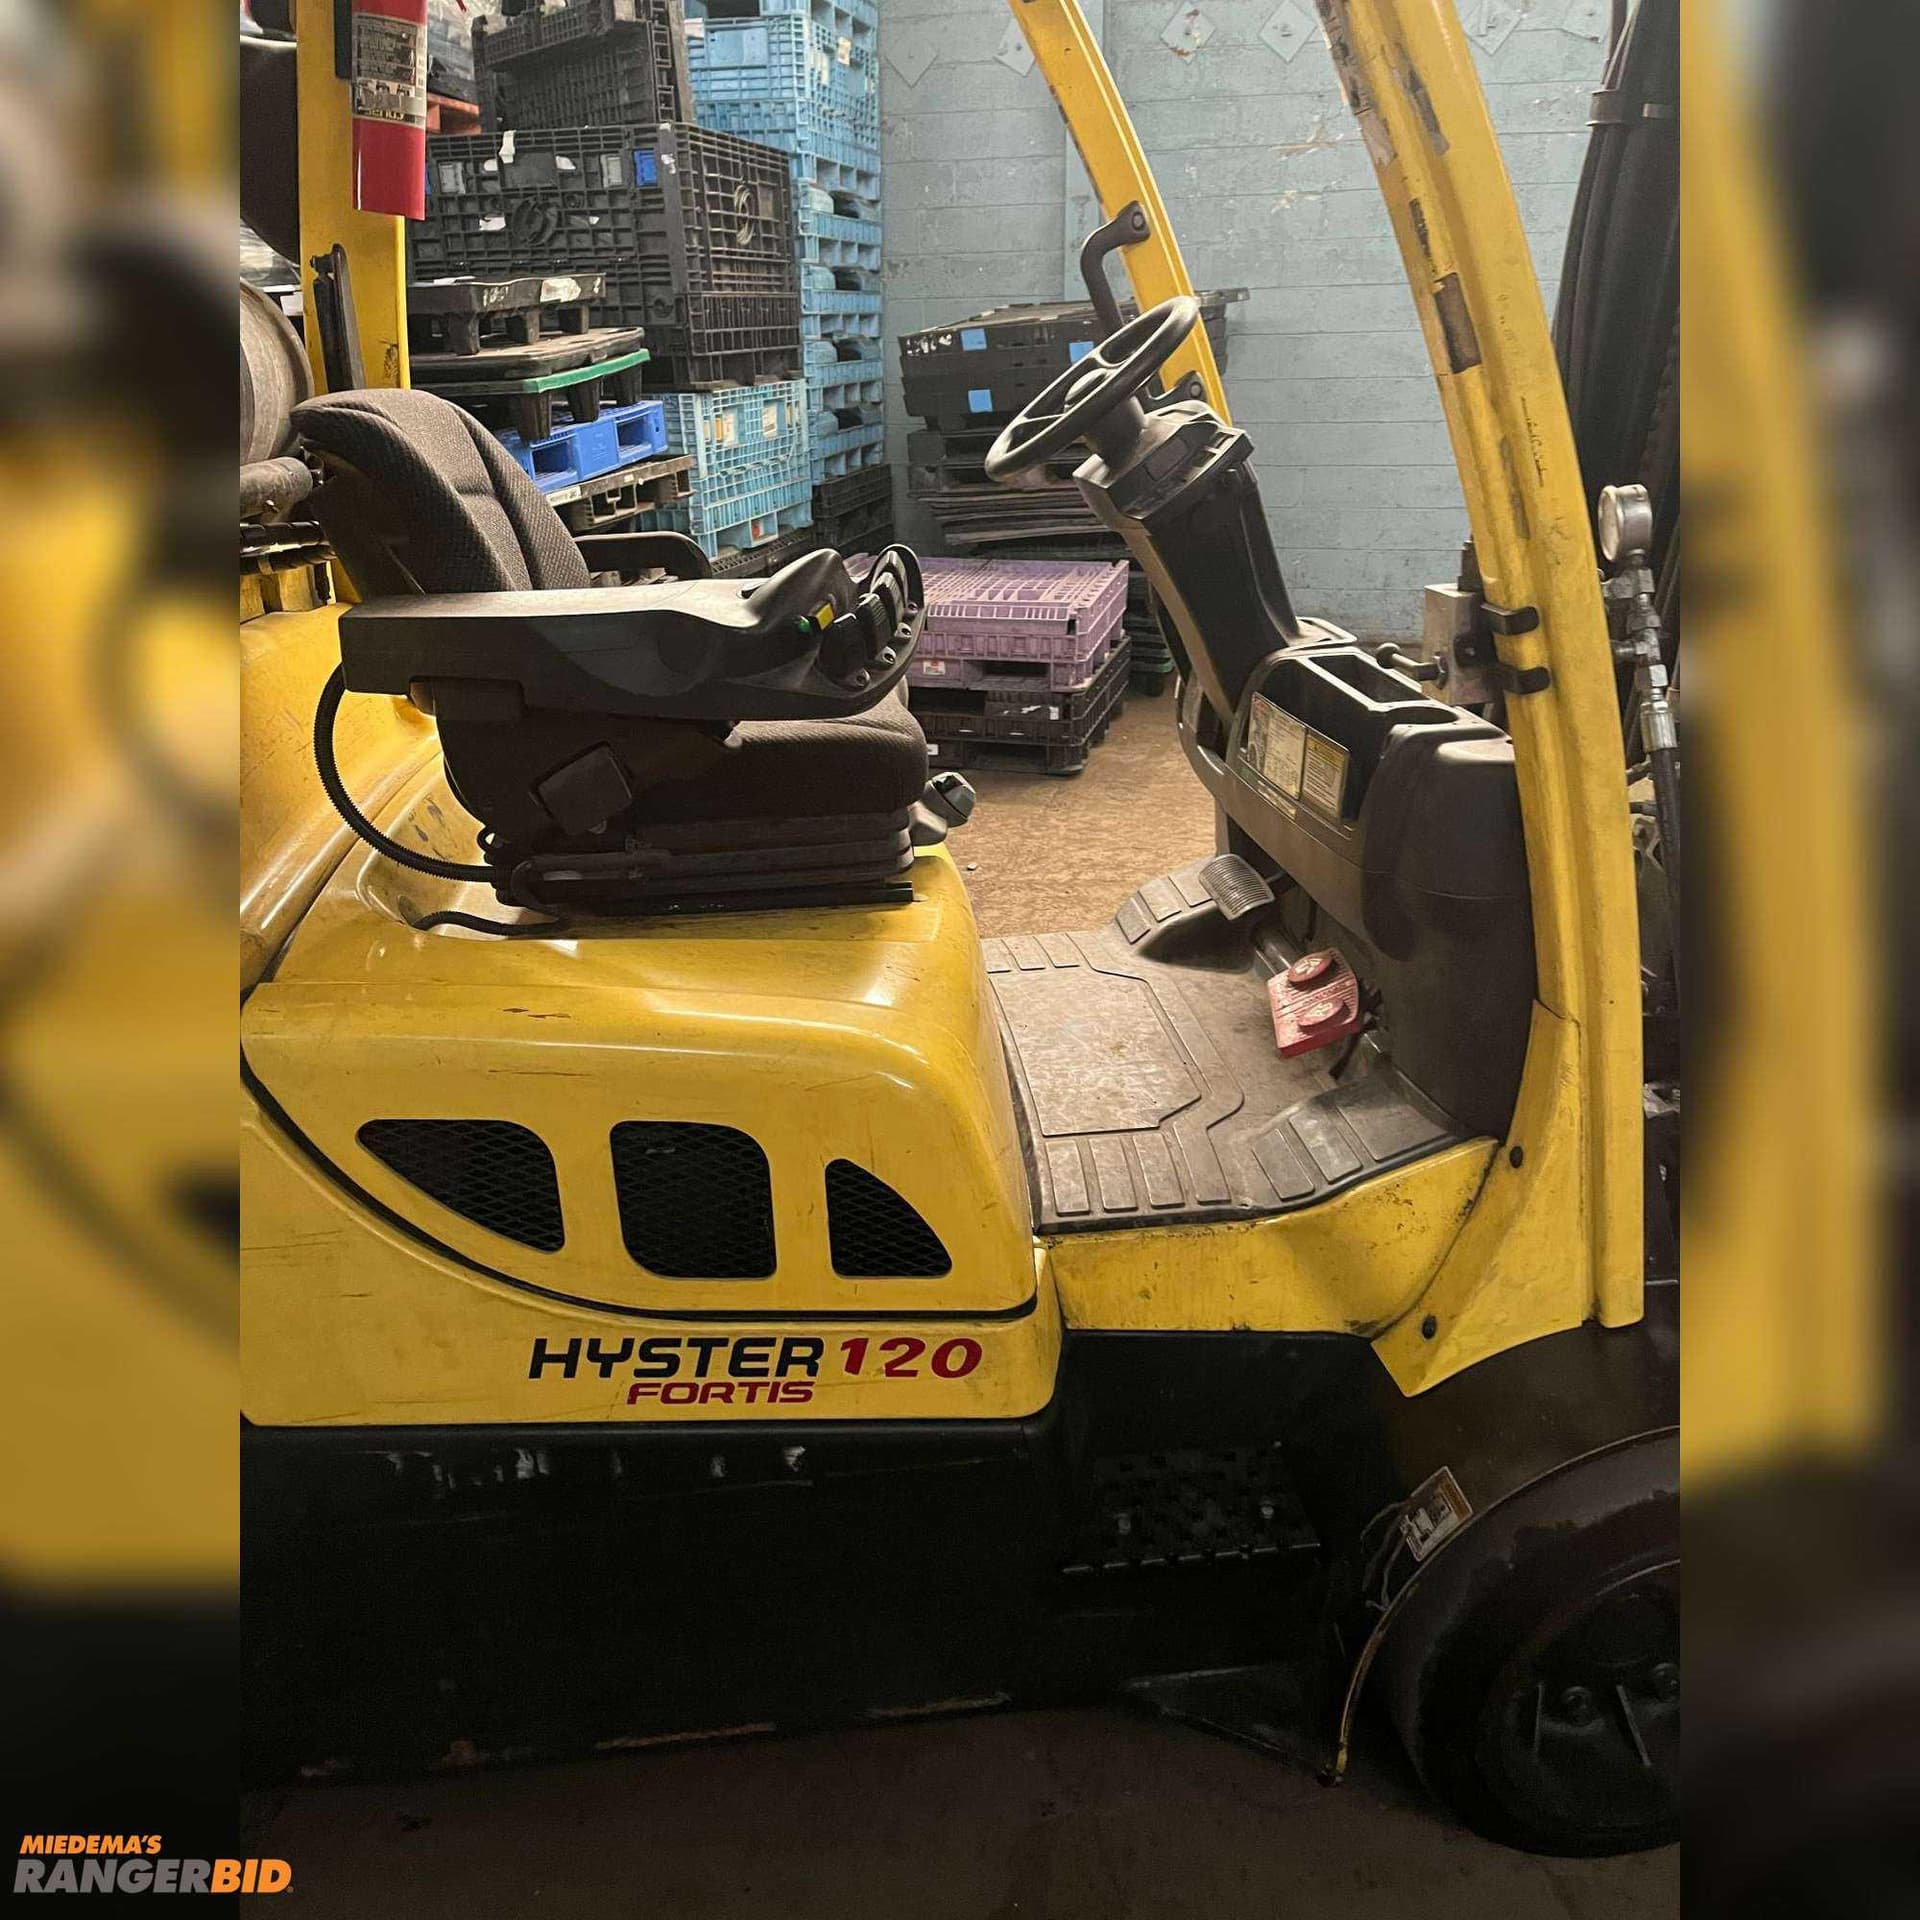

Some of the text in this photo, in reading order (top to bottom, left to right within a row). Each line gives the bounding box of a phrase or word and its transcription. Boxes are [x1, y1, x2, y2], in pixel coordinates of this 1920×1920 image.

[528, 1337, 983, 1379] HYSTER 120
[626, 1380, 815, 1405] FORTIS
